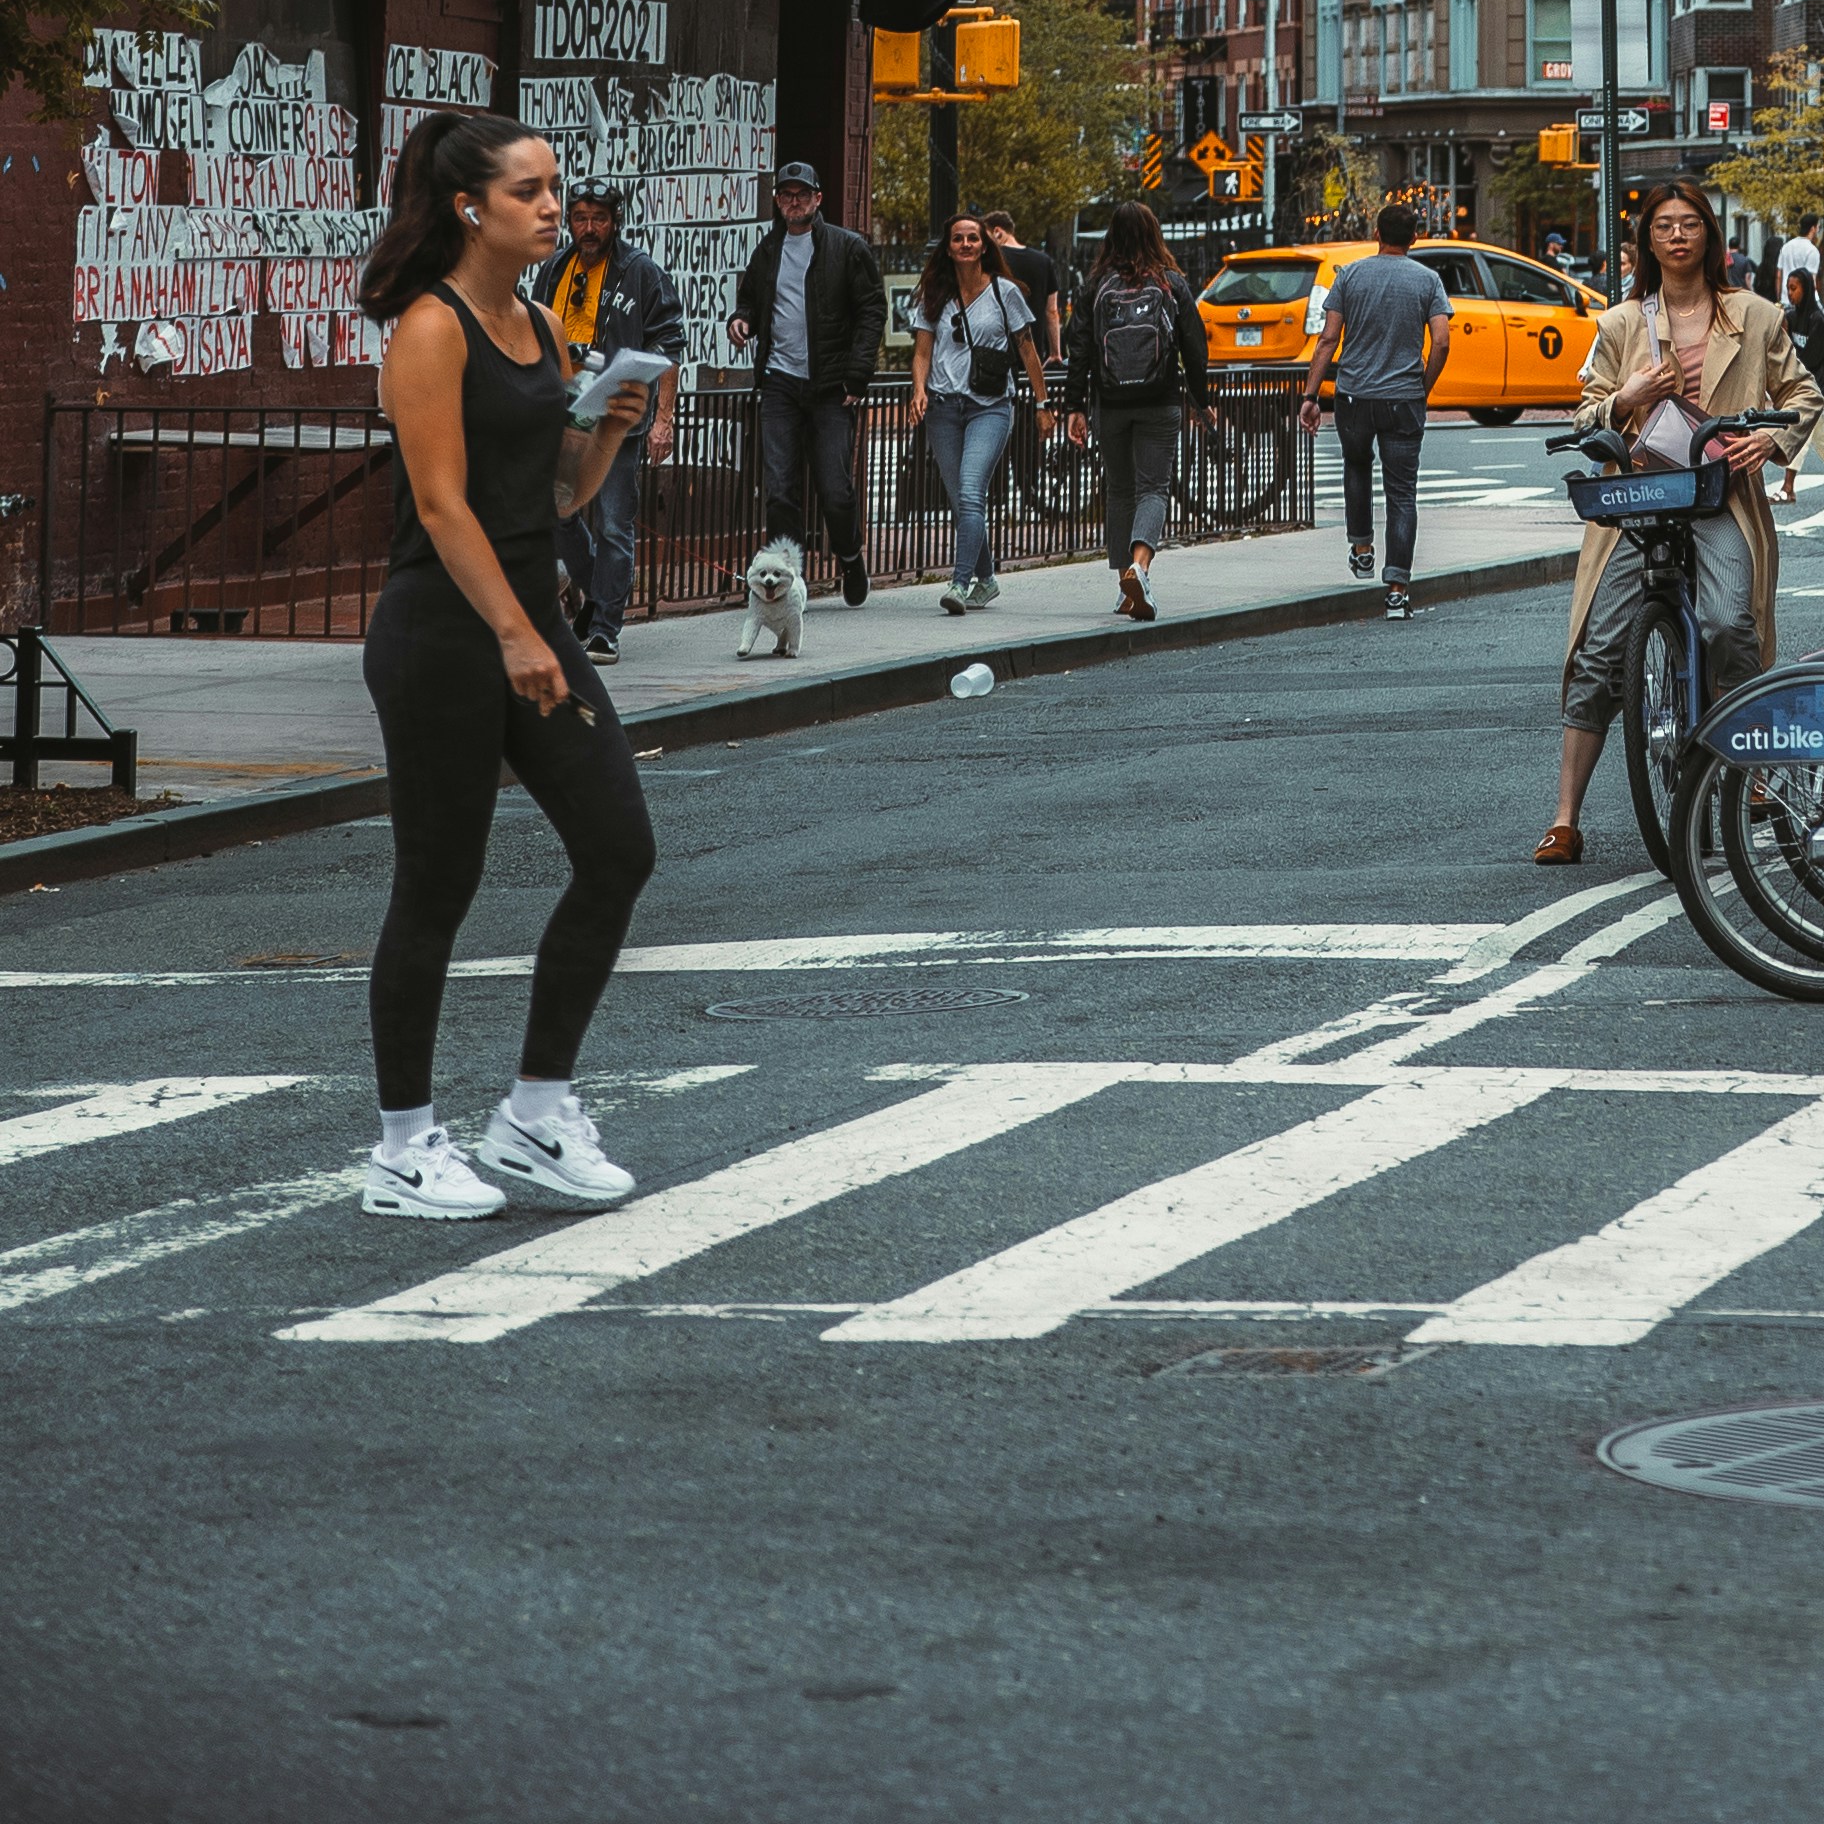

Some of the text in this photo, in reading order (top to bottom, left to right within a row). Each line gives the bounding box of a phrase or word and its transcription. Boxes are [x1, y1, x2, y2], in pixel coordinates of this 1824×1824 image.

[425, 49, 480, 102] BLACK
[521, 78, 587, 124] THOMAS
[714, 75, 767, 124] SANTOS
[1543, 330, 1558, 355] T
[1601, 485, 1665, 506] citi bike
[1730, 724, 1824, 751] citi bike
